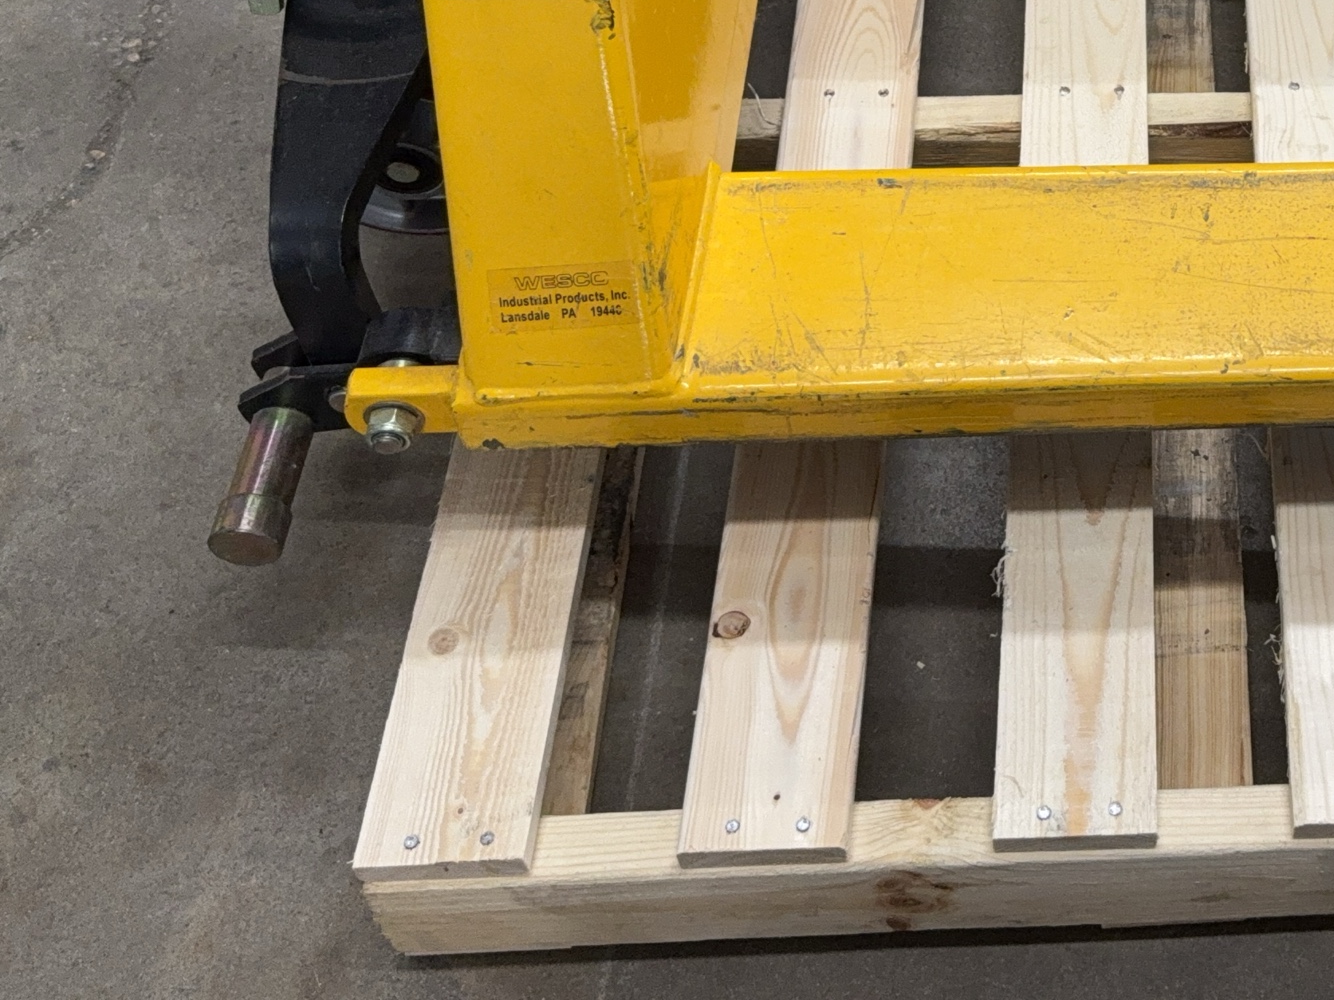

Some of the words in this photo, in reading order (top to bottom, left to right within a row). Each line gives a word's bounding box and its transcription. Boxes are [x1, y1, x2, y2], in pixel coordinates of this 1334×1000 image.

[499, 294, 552, 307] Industrial
[501, 310, 550, 323] Lansdale
[561, 308, 577, 319] PA
